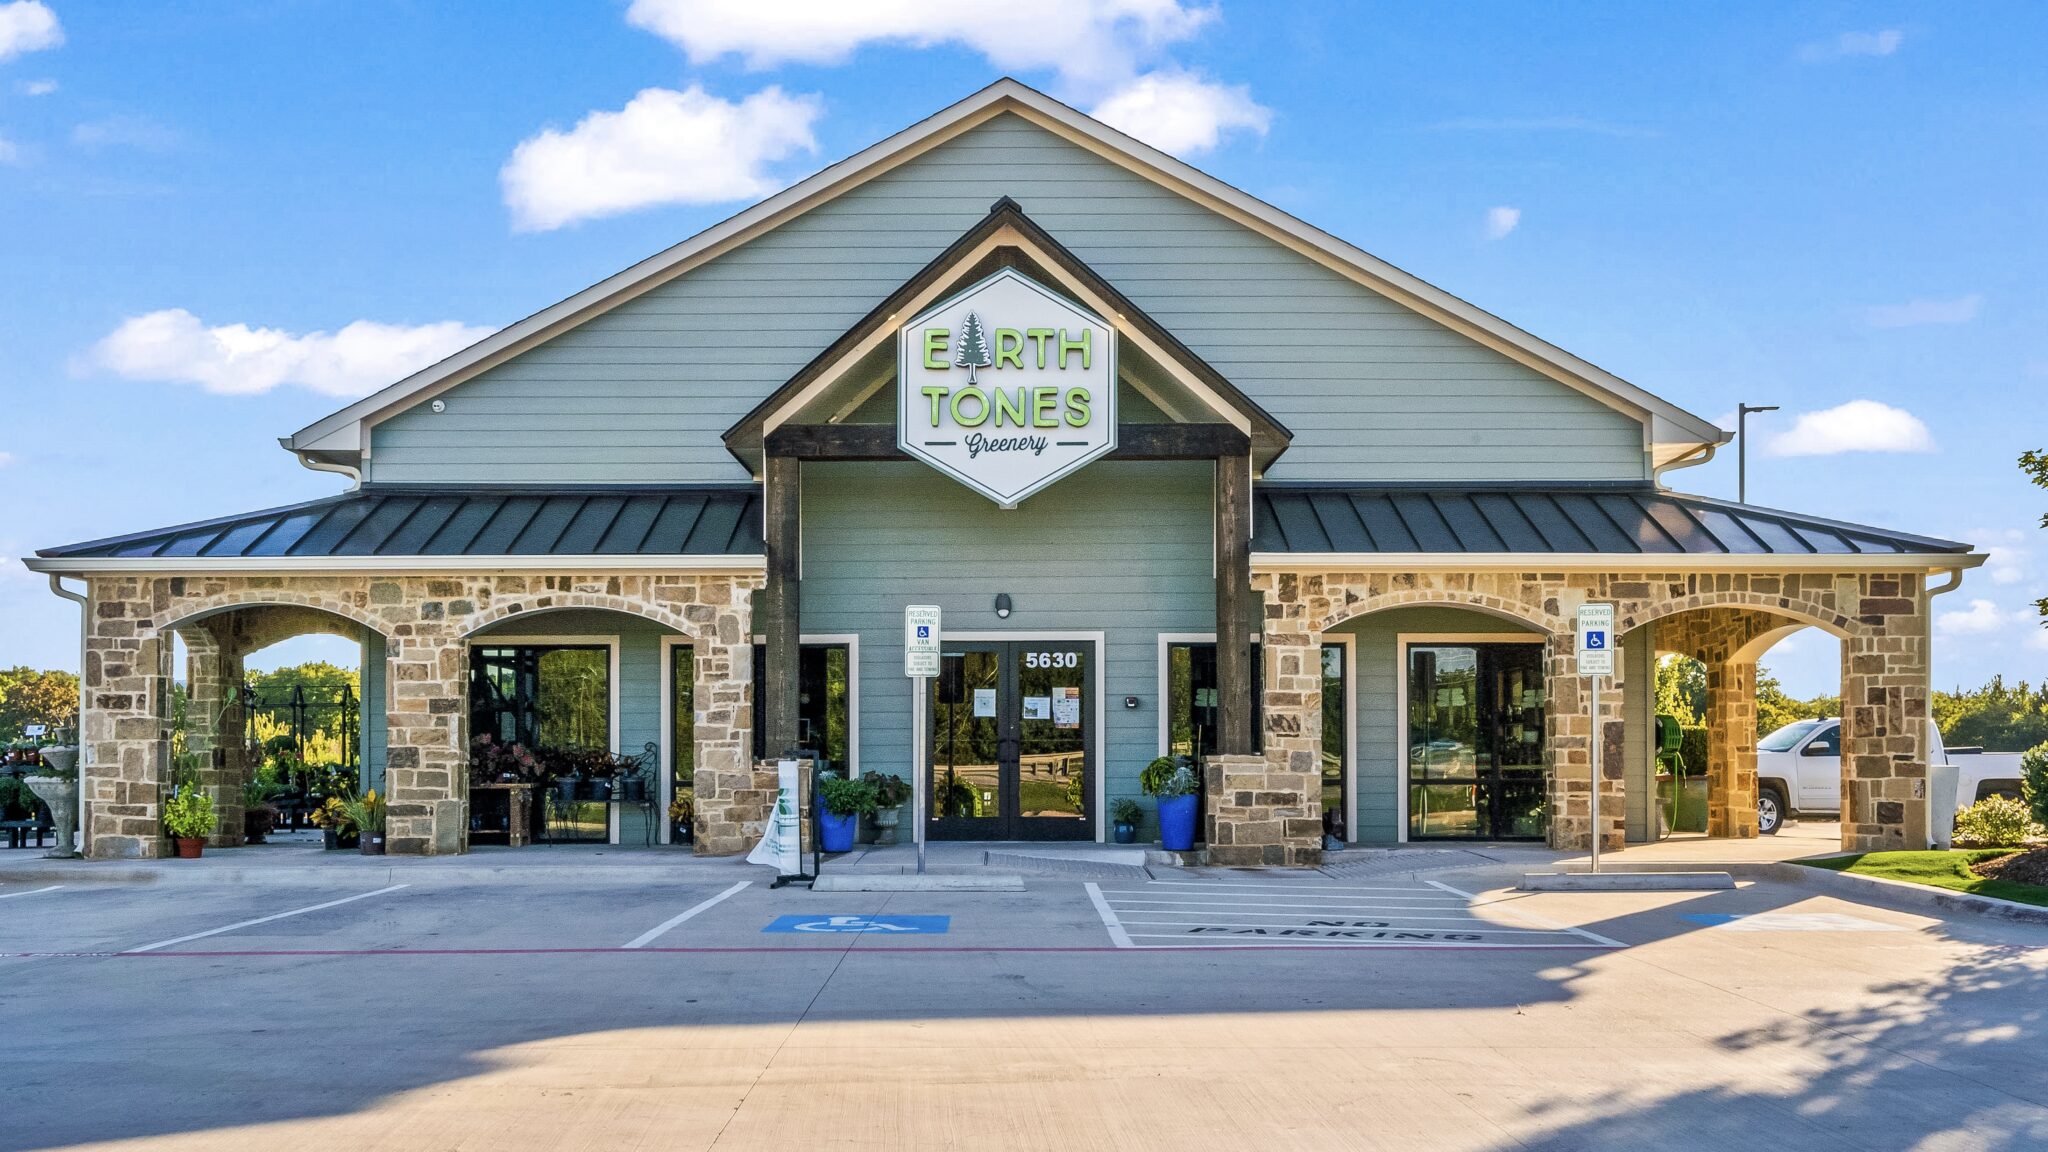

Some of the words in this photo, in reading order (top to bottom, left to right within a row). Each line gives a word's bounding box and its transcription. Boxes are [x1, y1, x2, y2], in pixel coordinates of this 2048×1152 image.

[921, 386, 1092, 428] TONES
[964, 432, 1049, 459] Greenery
[908, 610, 938, 618] RESERVED
[1025, 652, 1078, 669] 5630
[1306, 920, 1390, 928] NO
[1187, 927, 1483, 941] PARKING
